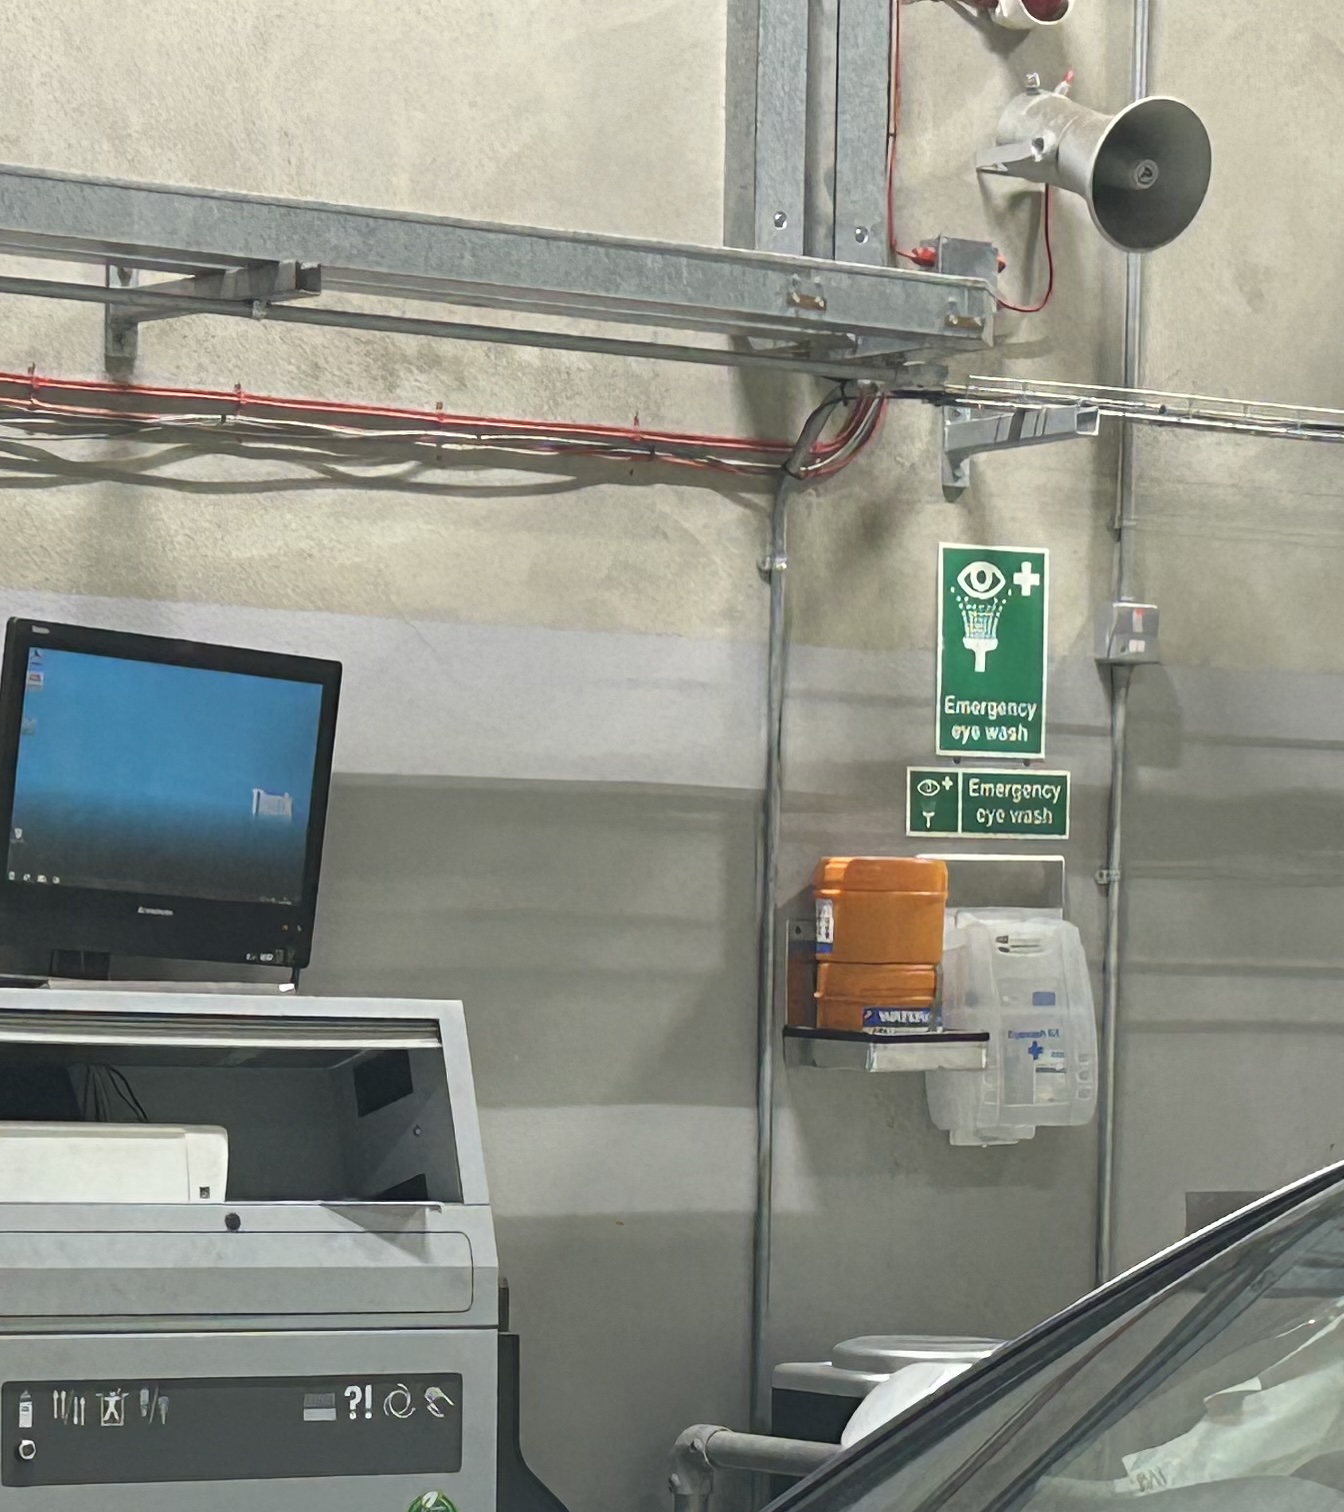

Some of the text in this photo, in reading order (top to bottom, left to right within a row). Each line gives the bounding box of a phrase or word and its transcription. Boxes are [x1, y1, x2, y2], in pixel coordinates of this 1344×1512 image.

[944, 695, 1037, 721] Emergency
[951, 723, 1028, 745] eye wash
[968, 778, 1061, 804] Emergency
[976, 807, 1053, 828] eye wash
